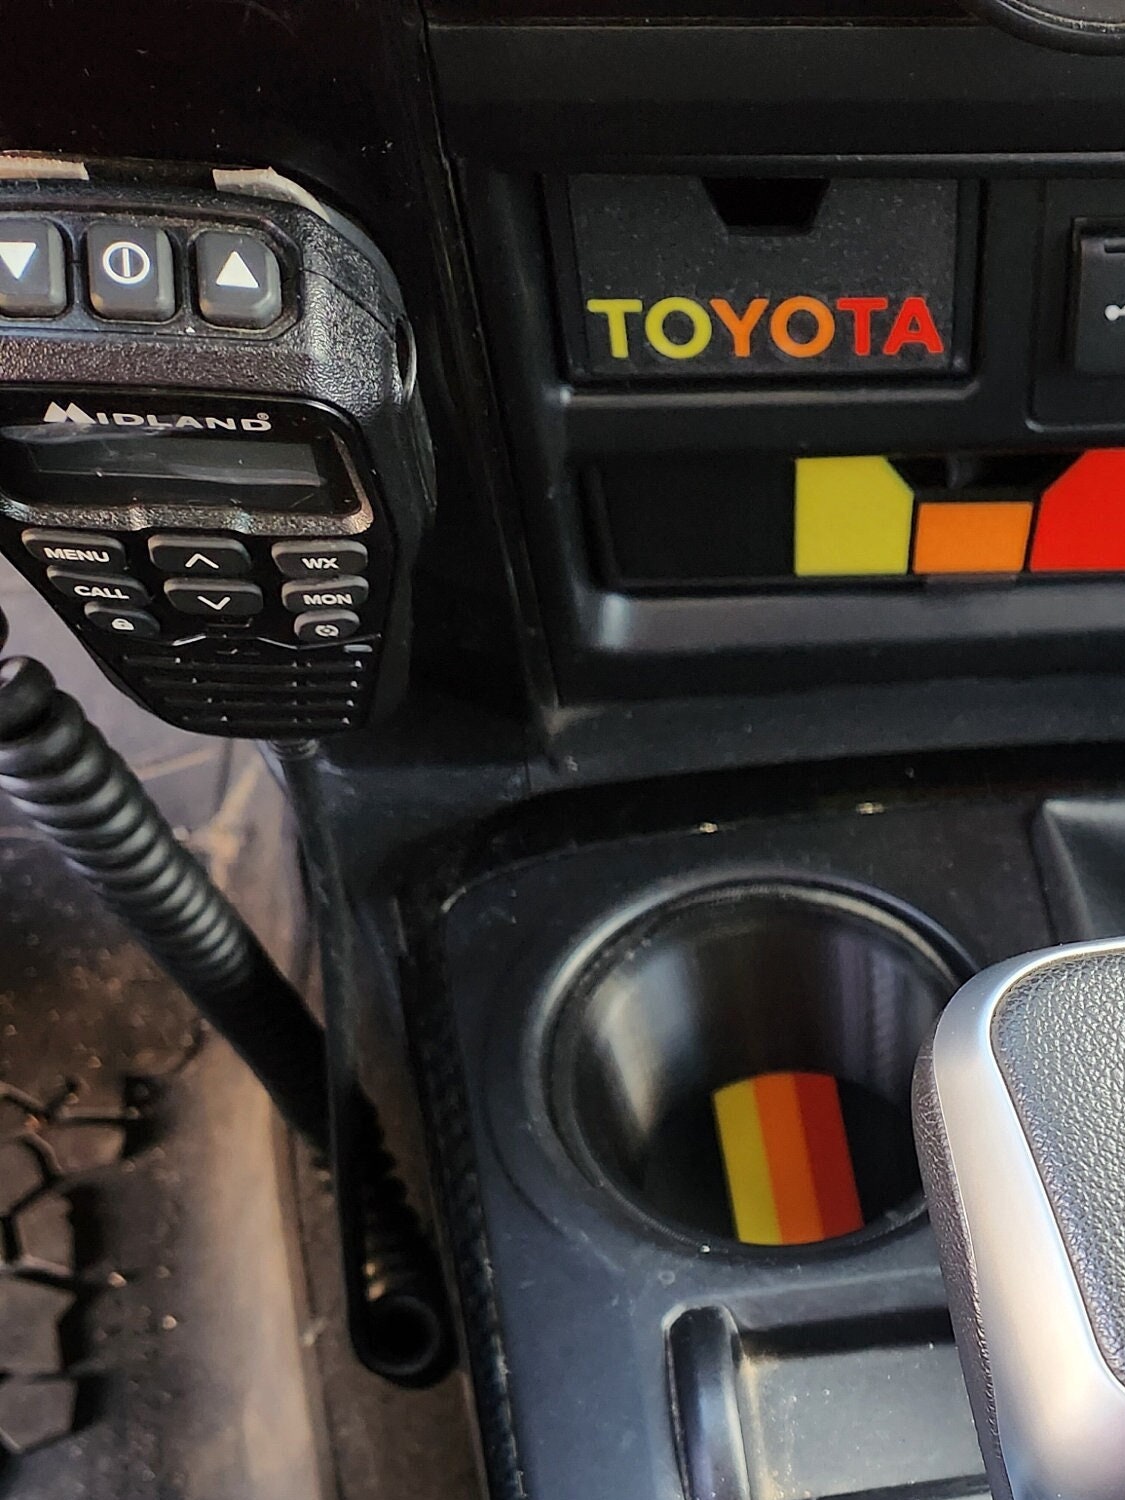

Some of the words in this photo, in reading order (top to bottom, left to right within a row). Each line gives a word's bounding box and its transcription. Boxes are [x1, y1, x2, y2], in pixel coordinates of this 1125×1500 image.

[586, 295, 944, 359] TOYOTA
[43, 547, 110, 563] MENU
[301, 557, 339, 570] WX
[73, 585, 129, 600] CALL
[302, 593, 353, 605] MON
